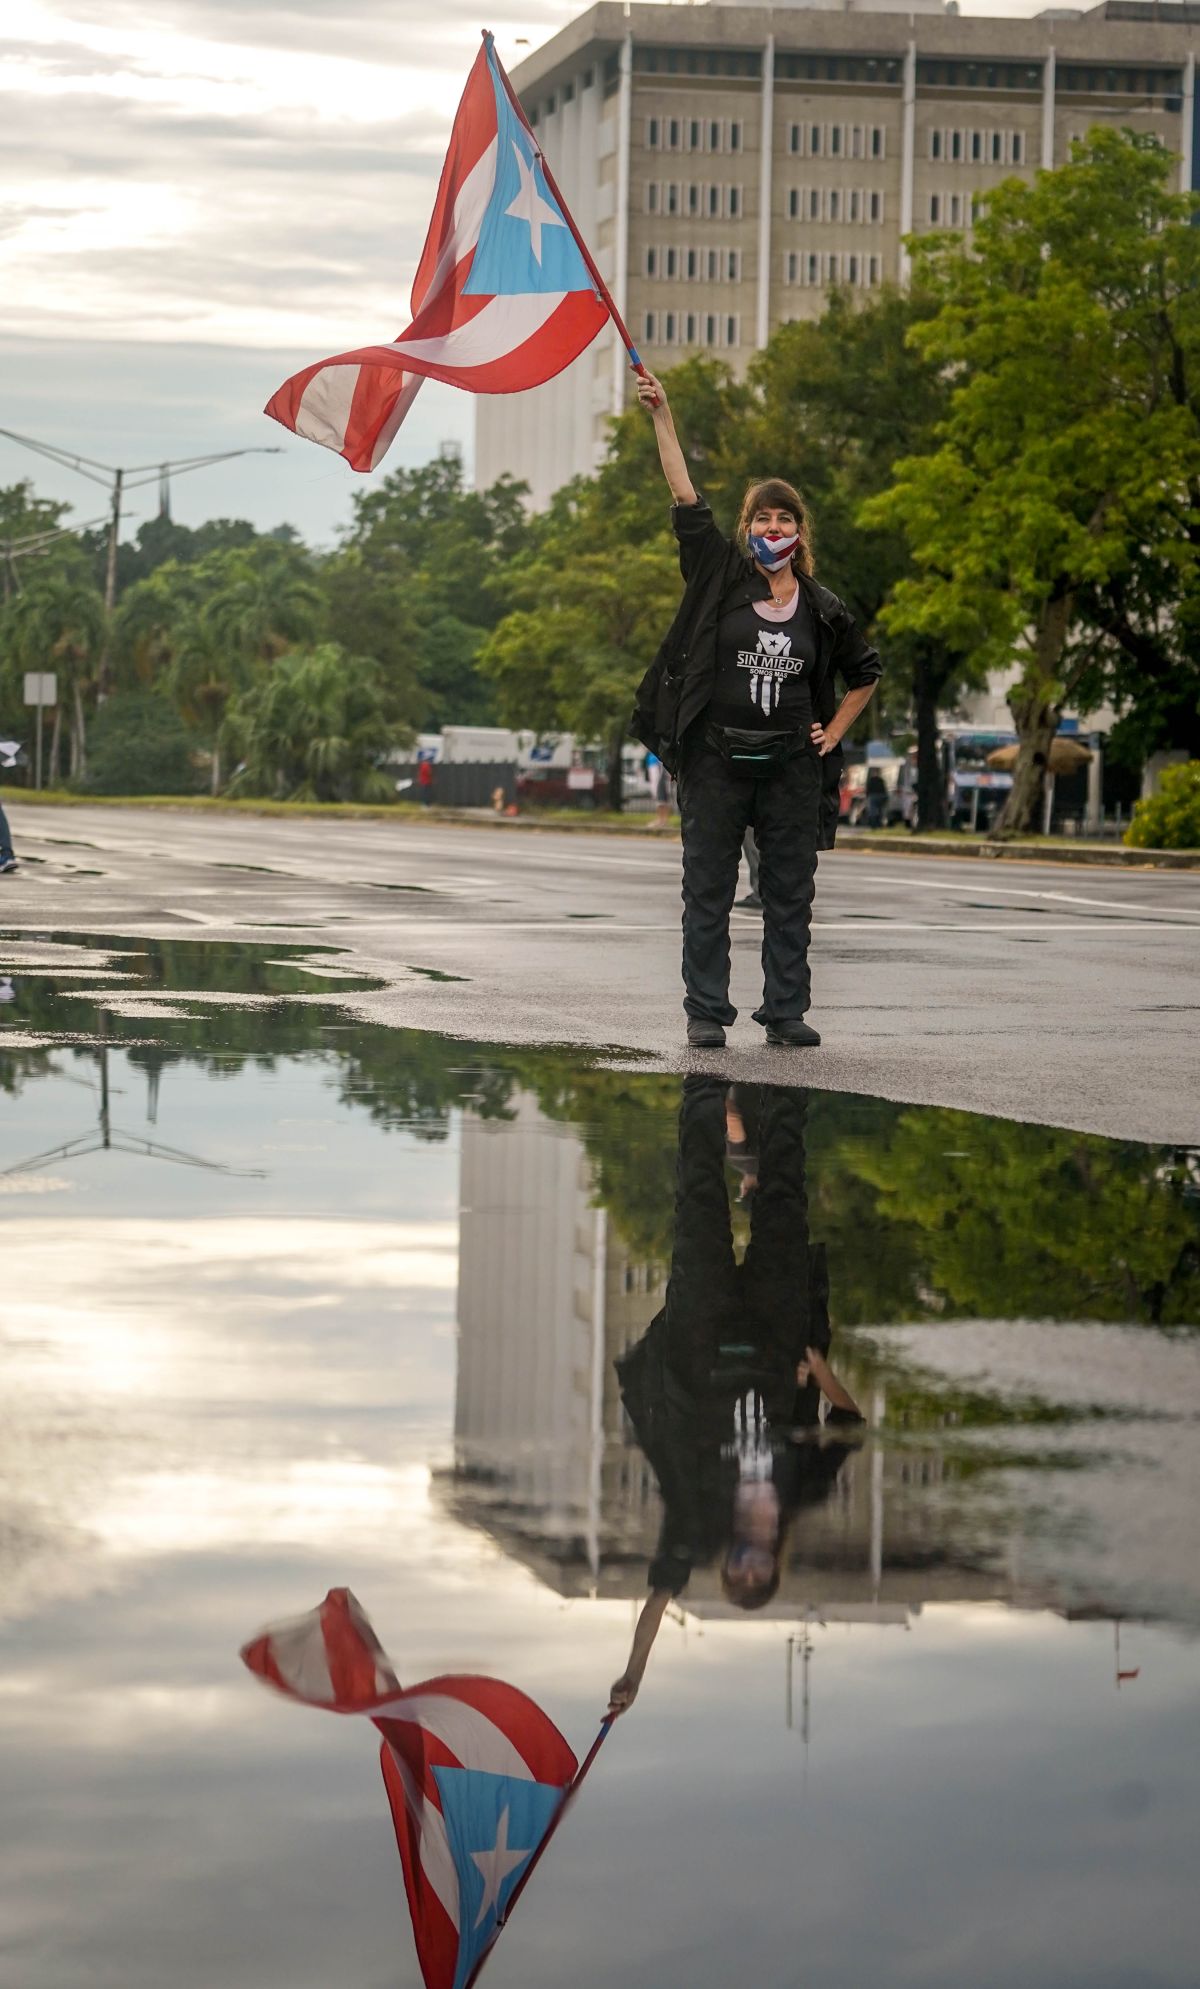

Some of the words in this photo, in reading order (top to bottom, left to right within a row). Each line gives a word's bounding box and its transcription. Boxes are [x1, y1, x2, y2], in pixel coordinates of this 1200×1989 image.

[737, 653, 758, 666] SIN
[761, 656, 803, 672] MIEDO
[749, 668, 773, 677] SOMOS
